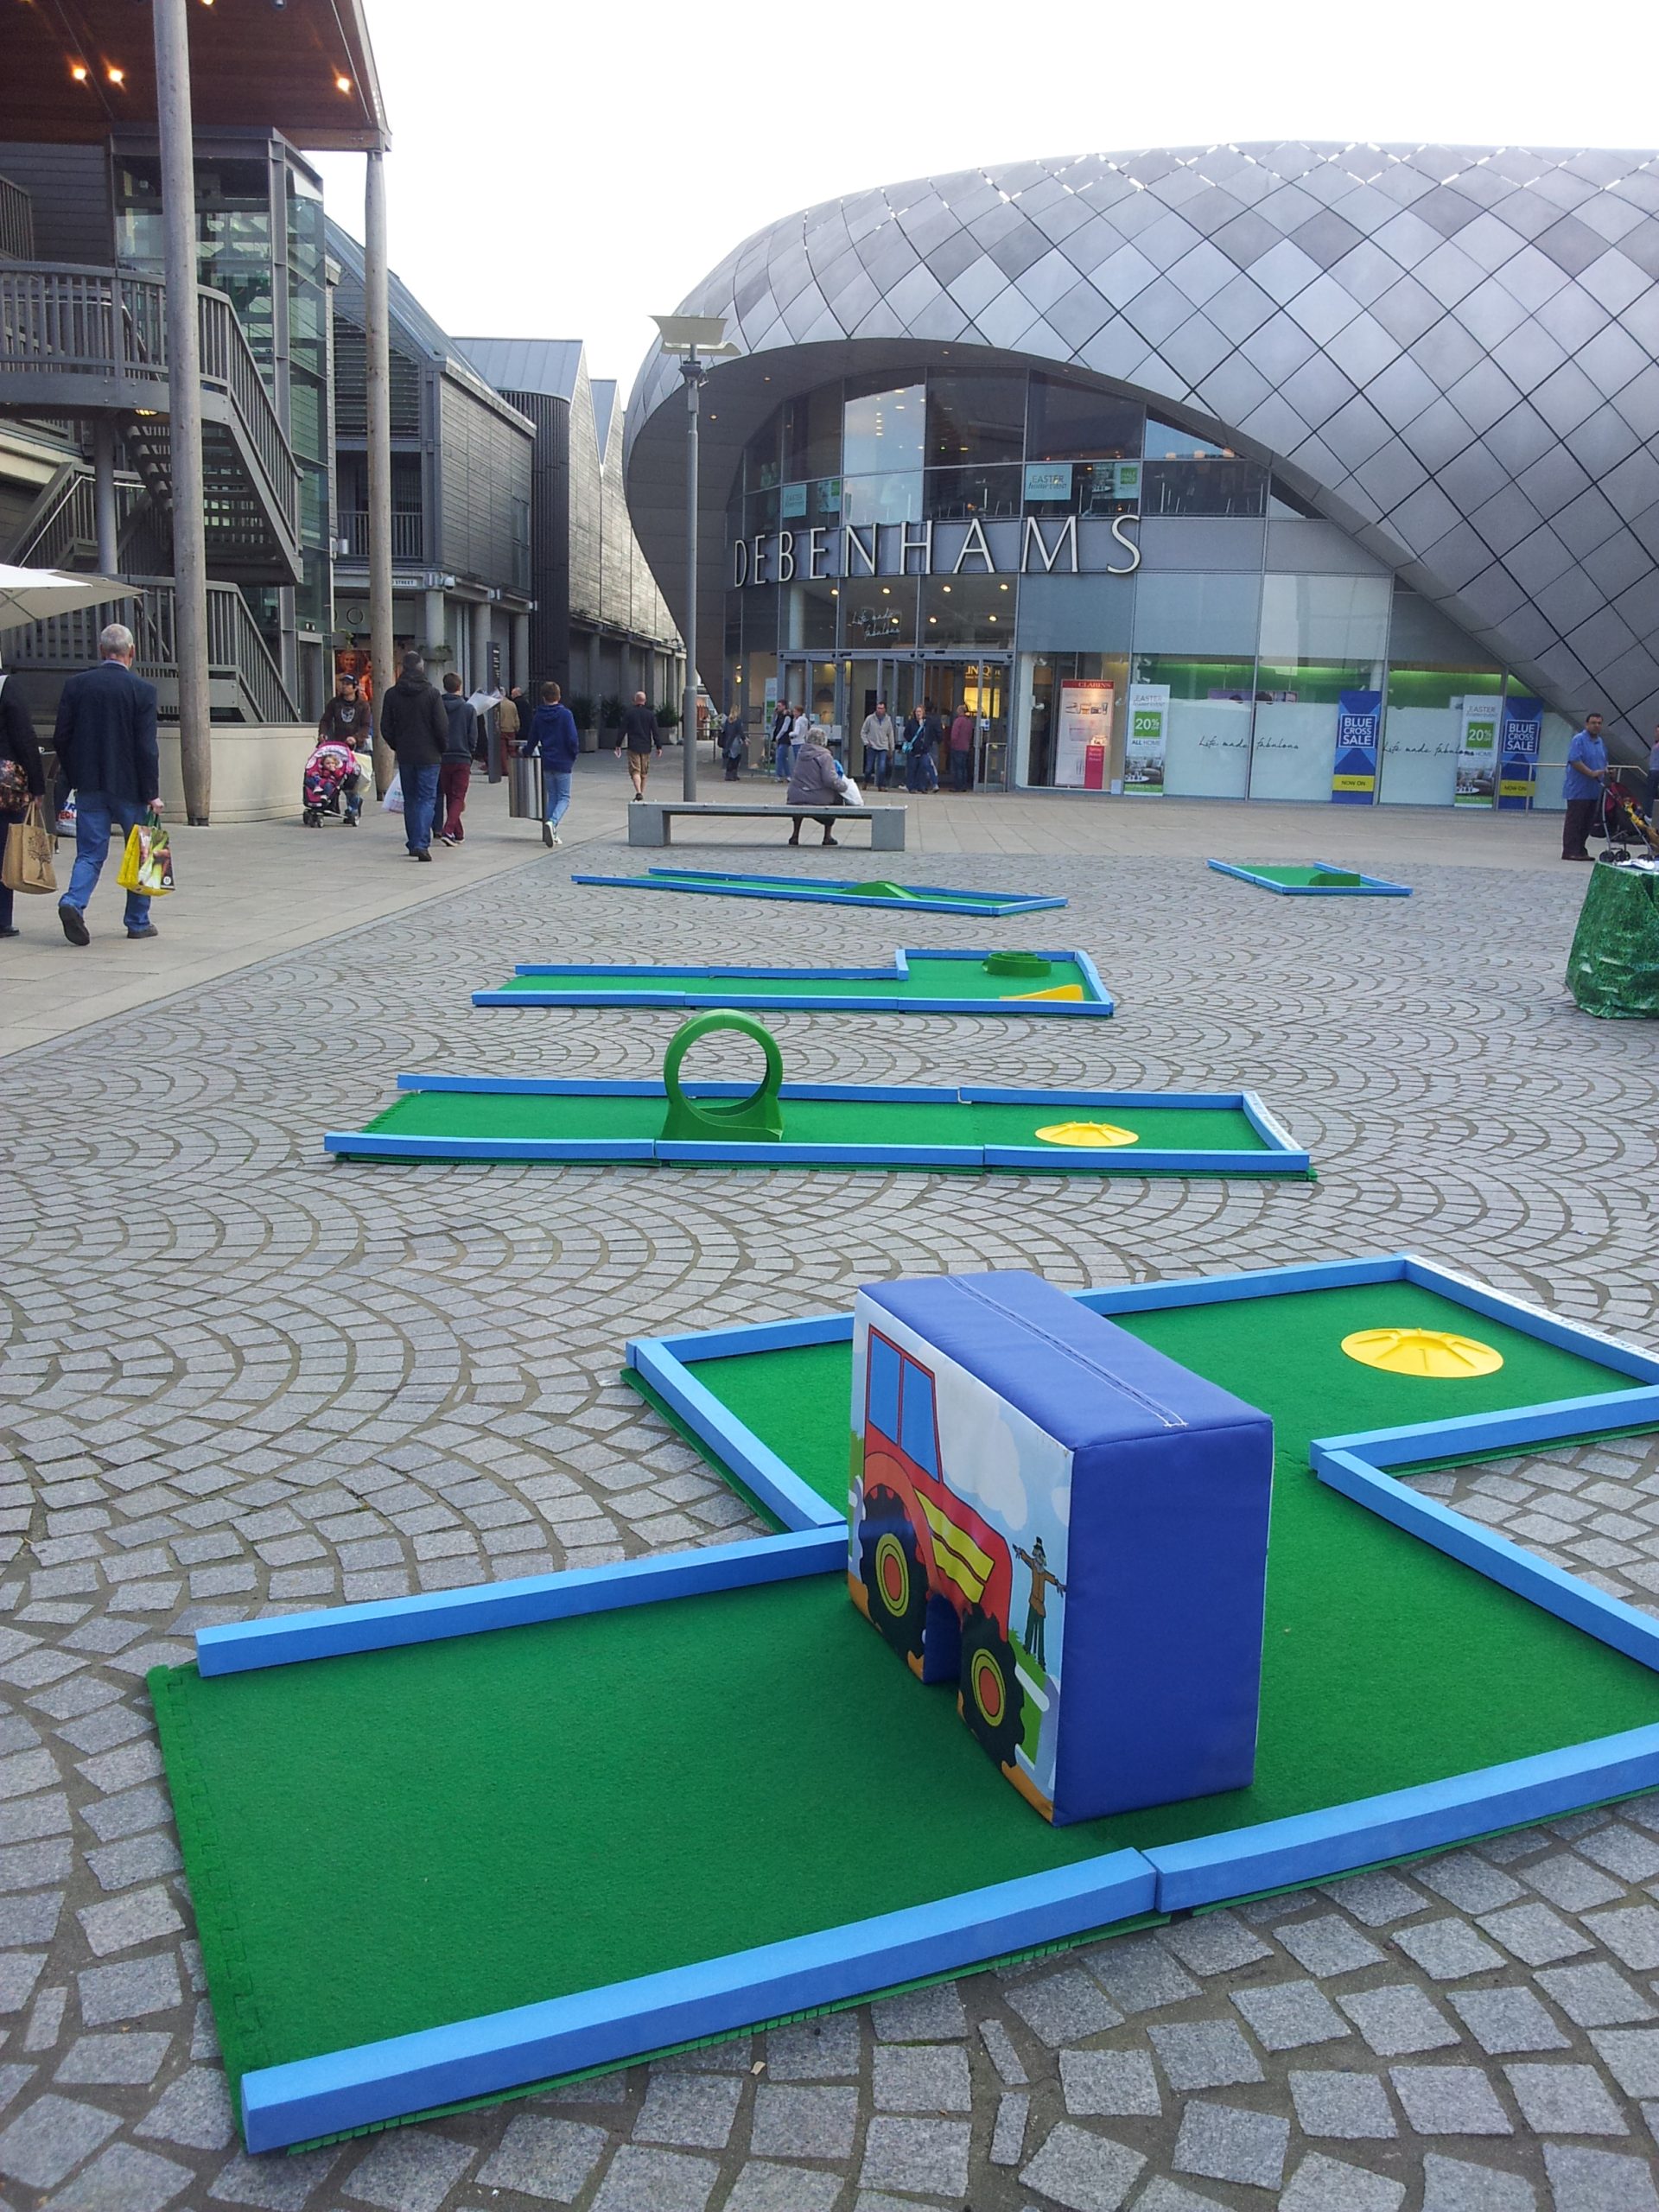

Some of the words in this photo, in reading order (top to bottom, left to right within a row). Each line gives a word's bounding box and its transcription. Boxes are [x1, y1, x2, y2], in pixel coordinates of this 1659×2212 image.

[734, 514, 1141, 588] DEBENHAMS
[1344, 717, 1373, 727] BLUE
[1343, 727, 1372, 735] CROSS
[1509, 723, 1535, 733] BLUE
[1342, 735, 1371, 745] SALE
[1507, 741, 1534, 751] SALE
